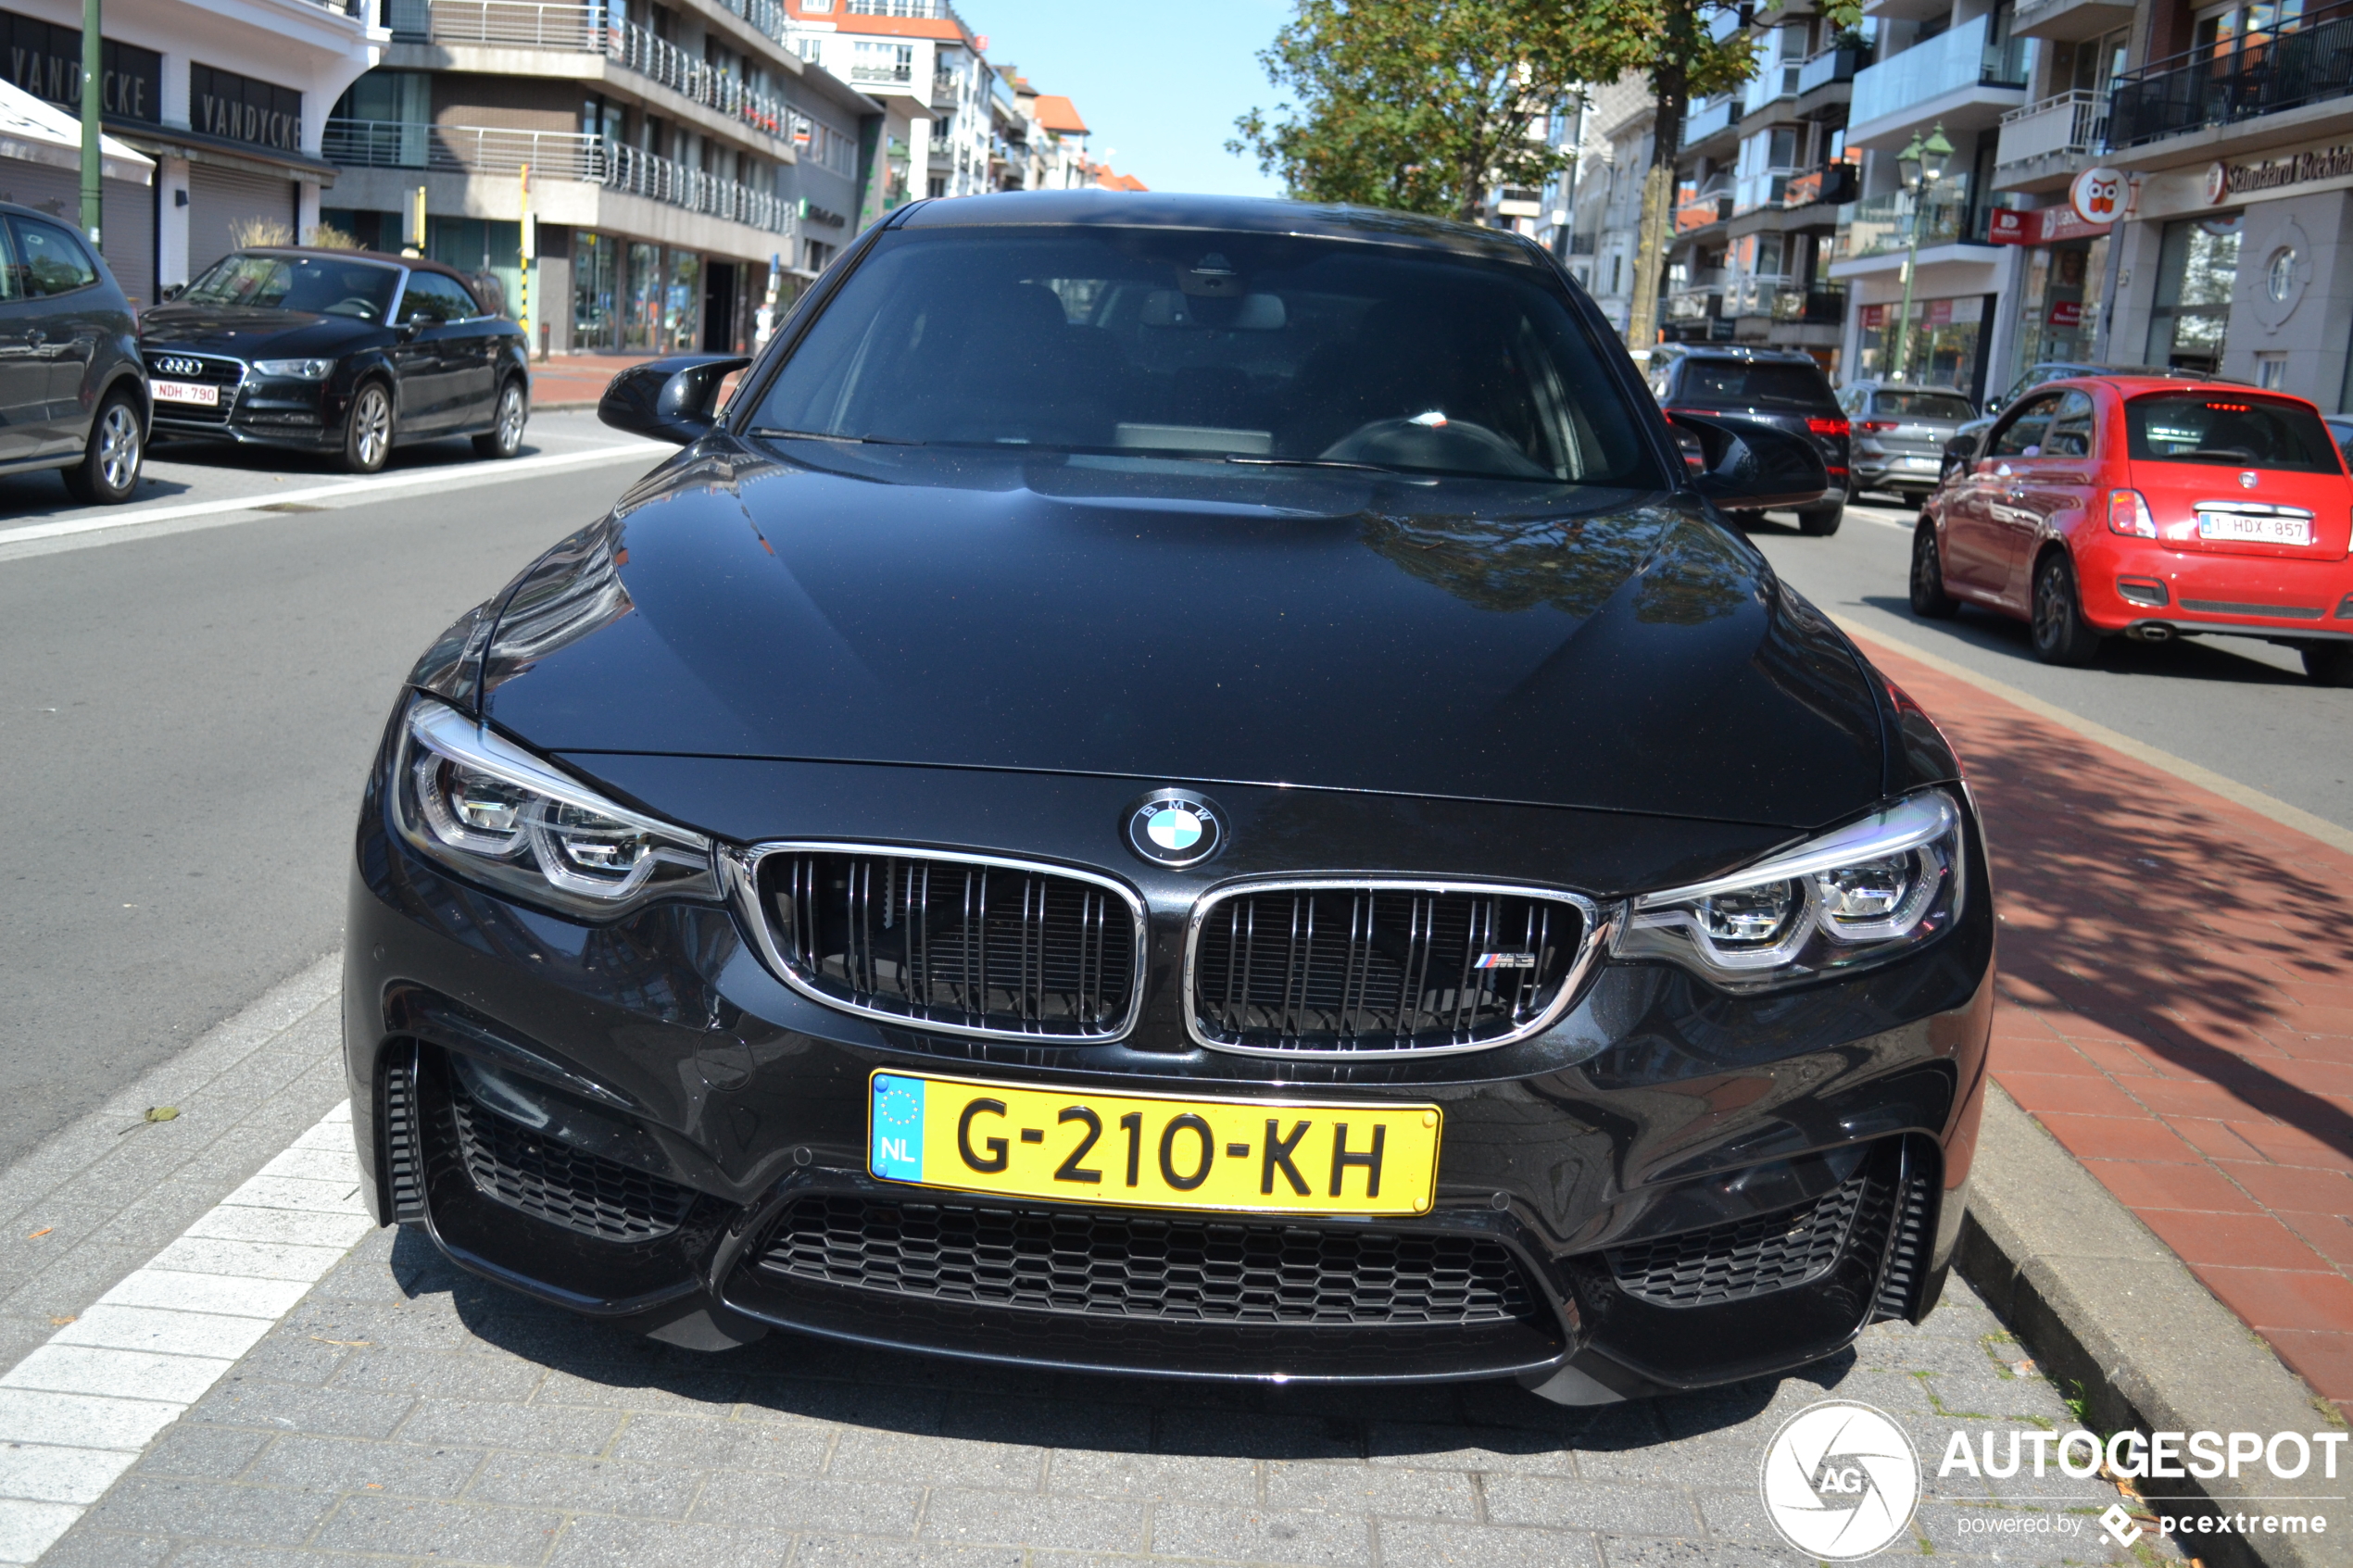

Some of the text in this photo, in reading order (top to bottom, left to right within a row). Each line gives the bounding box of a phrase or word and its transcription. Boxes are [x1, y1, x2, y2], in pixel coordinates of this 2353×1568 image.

[11, 46, 145, 118] VANDCKE
[203, 94, 302, 151] VANDYCKE
[2227, 144, 2353, 194] Standaard Boekha
[1140, 799, 1212, 822] BMW
[1491, 952, 1535, 968] M3
[881, 1136, 916, 1162] NL
[957, 1097, 1387, 1198] G-210-KH
